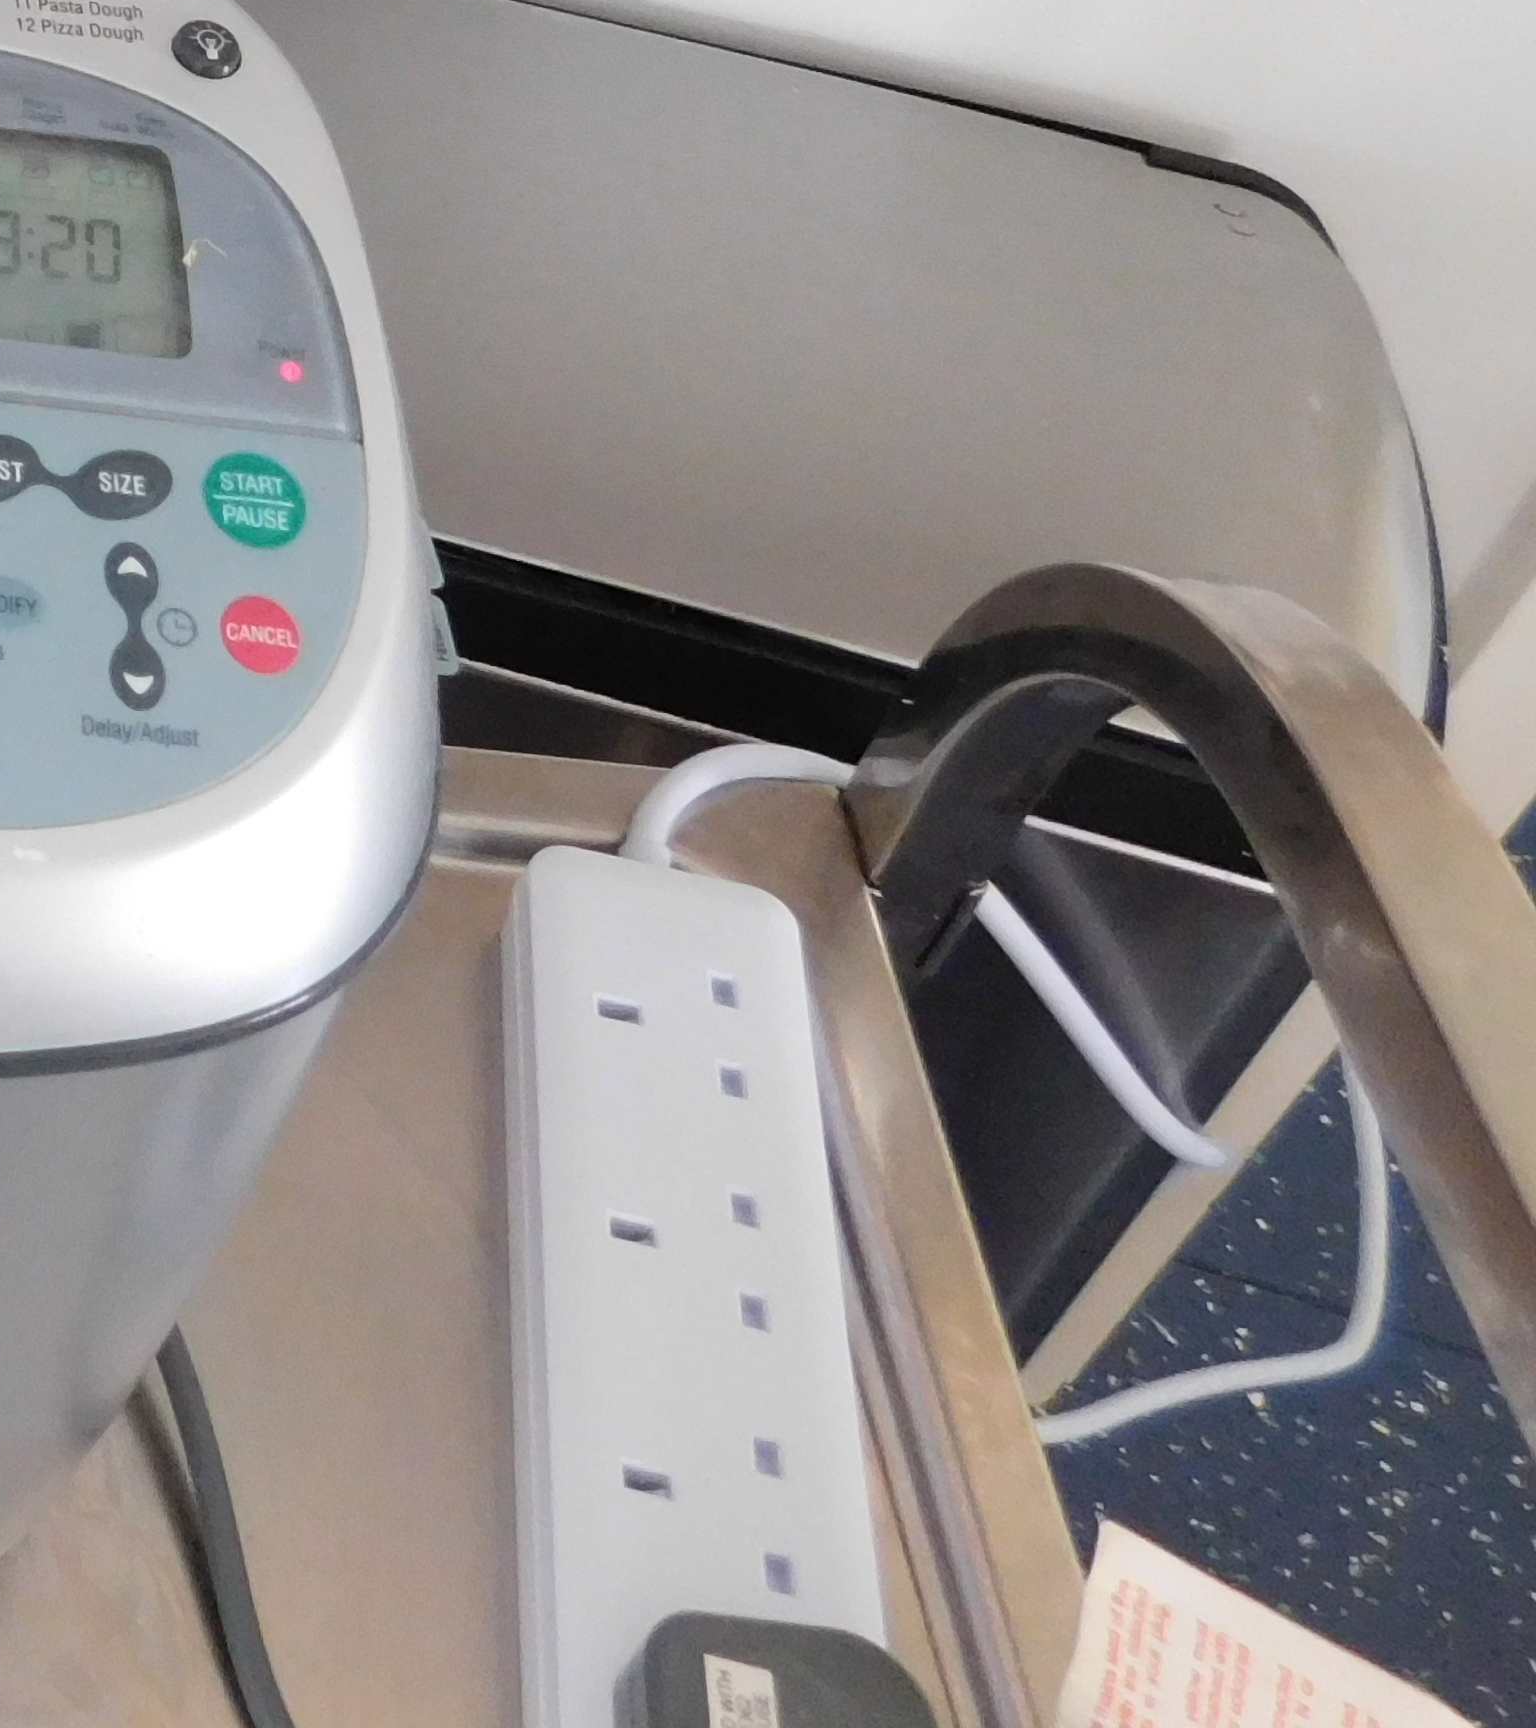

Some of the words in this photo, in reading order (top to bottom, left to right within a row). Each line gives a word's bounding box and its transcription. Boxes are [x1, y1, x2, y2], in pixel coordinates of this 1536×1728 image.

[89, 1, 143, 21] Dough
[17, 17, 37, 33] 12
[41, 19, 84, 37] Pizza
[89, 23, 144, 43] Dough
[98, 472, 146, 496] SIZE
[219, 472, 285, 498] START
[221, 503, 290, 532] PAUSE
[225, 623, 298, 650] CANCEL
[81, 714, 199, 748] Delay/Adjust
